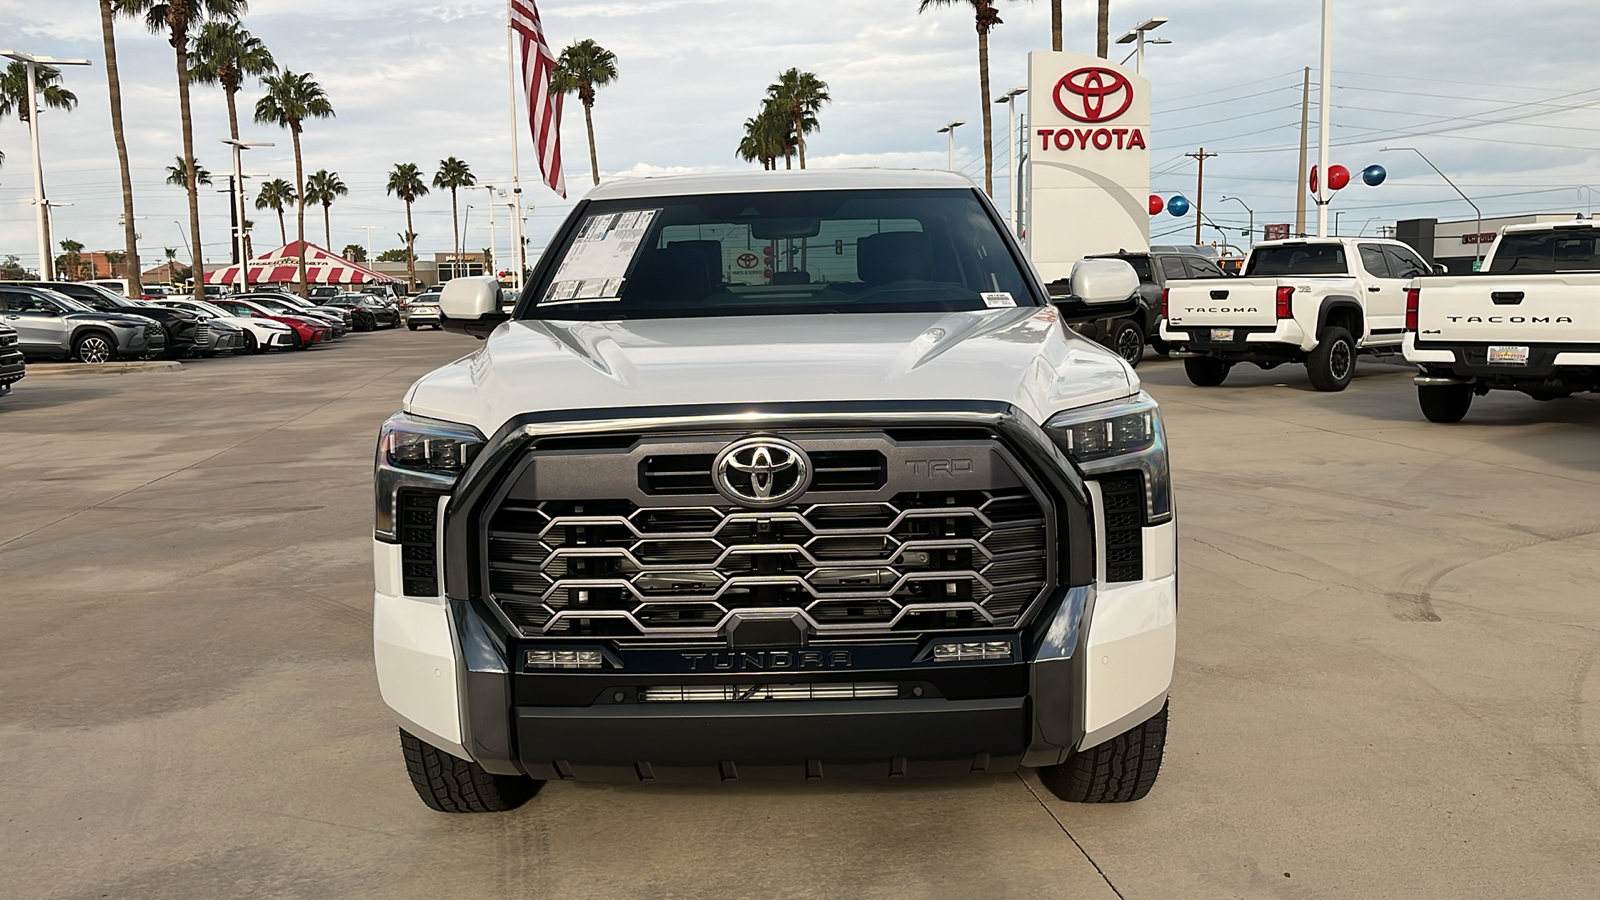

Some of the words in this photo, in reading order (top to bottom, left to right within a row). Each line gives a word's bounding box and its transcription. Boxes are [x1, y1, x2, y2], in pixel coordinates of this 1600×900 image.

[1037, 128, 1146, 151] TOYOTA
[905, 459, 973, 479] TRD
[681, 651, 853, 670] TUNDRA
